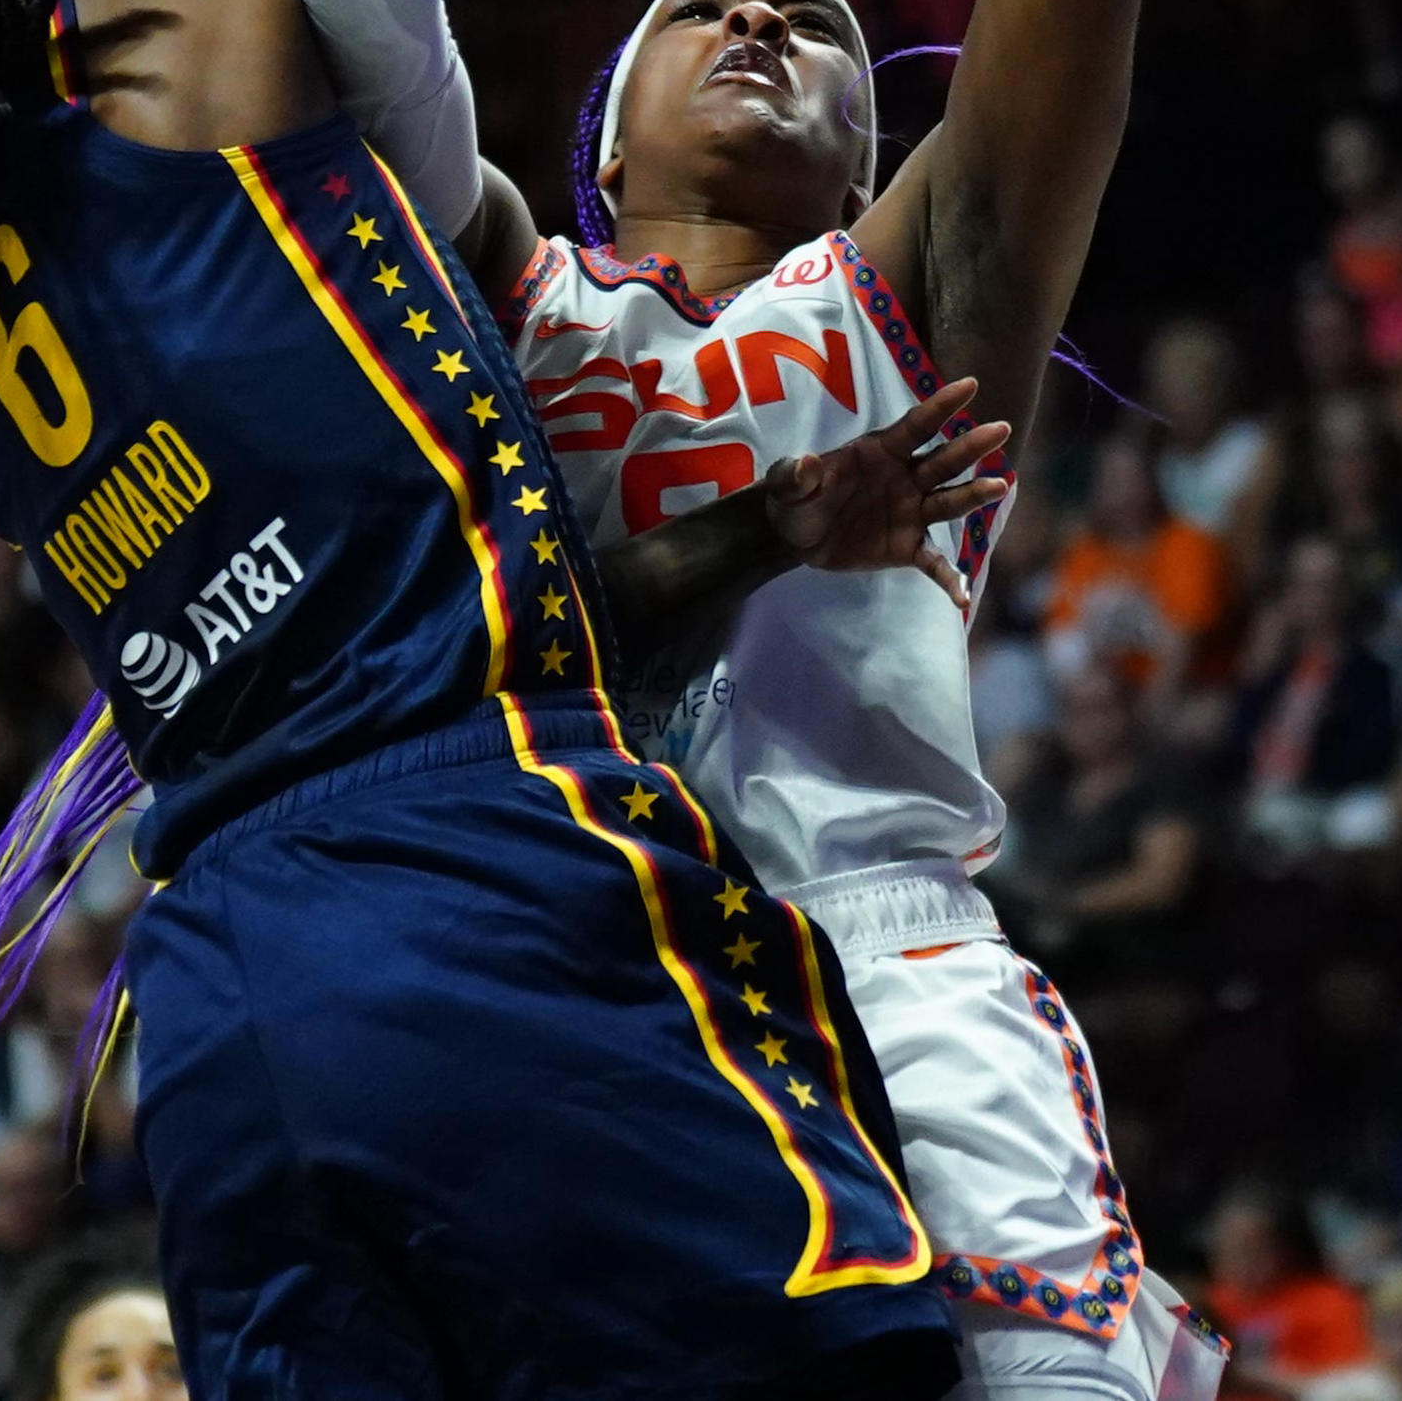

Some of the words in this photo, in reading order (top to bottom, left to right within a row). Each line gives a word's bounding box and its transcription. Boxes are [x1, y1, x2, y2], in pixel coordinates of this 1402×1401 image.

[527, 328, 858, 451] SUN
[43, 420, 212, 616] HOWARD
[183, 517, 305, 665] AT&T
